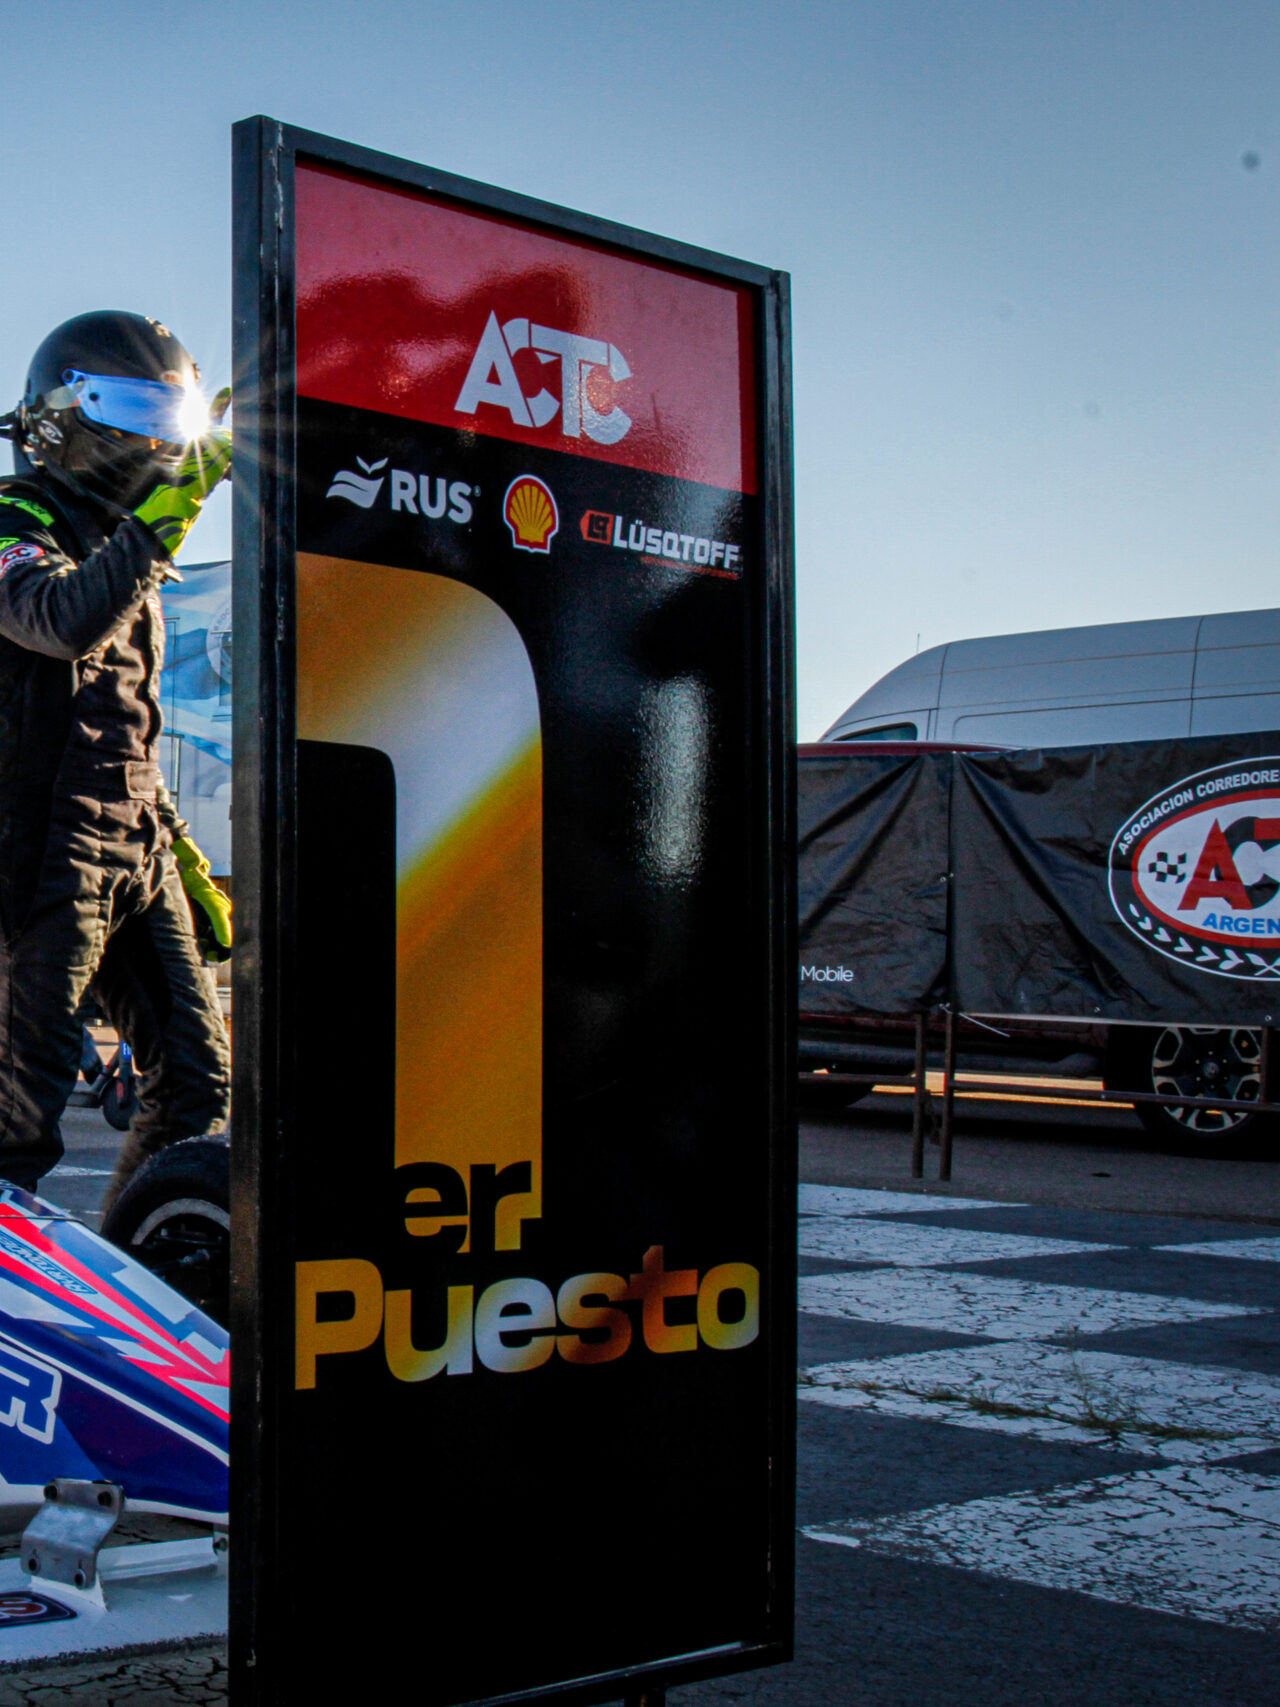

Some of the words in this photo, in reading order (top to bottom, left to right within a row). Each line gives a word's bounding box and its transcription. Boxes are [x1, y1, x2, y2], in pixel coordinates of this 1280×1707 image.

[453, 309, 632, 446] ACTC
[390, 469, 474, 524] RUS
[1117, 788, 1194, 856] ASOCIACION
[1196, 769, 1280, 798] CORREDORE
[1177, 817, 1280, 911] AC
[800, 965, 854, 982] Mobile
[394, 1160, 533, 1253] er
[295, 1245, 760, 1390] Puesto
